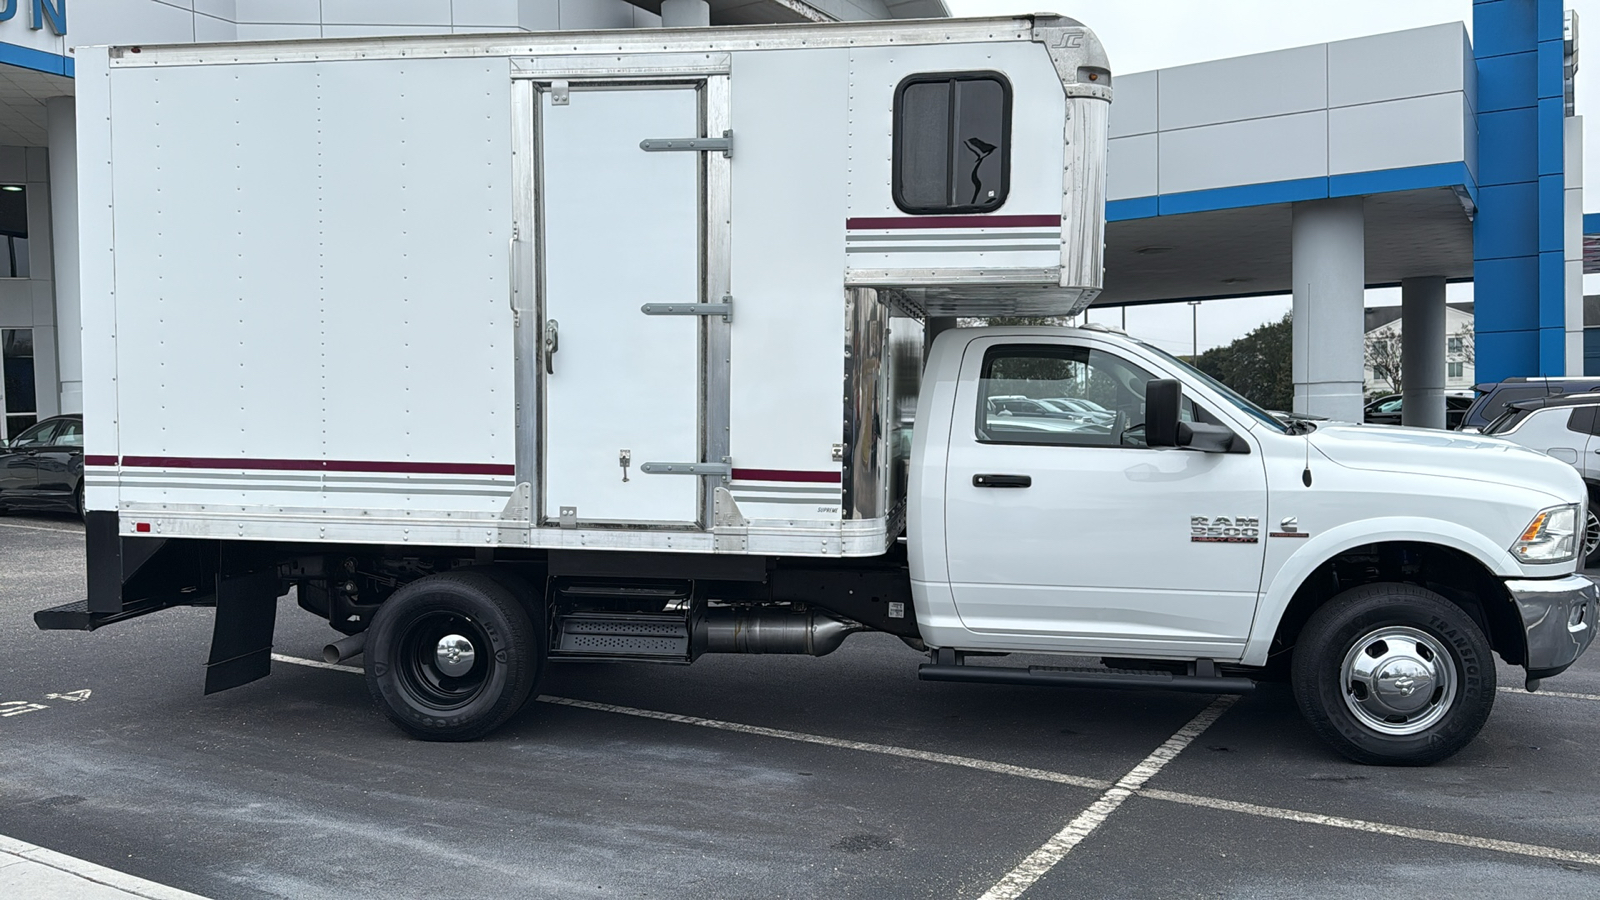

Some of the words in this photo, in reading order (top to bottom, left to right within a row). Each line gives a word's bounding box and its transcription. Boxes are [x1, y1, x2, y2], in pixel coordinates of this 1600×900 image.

[0, 0, 67, 36] N
[1191, 516, 1259, 527] RAM
[1191, 527, 1259, 537] 3500
